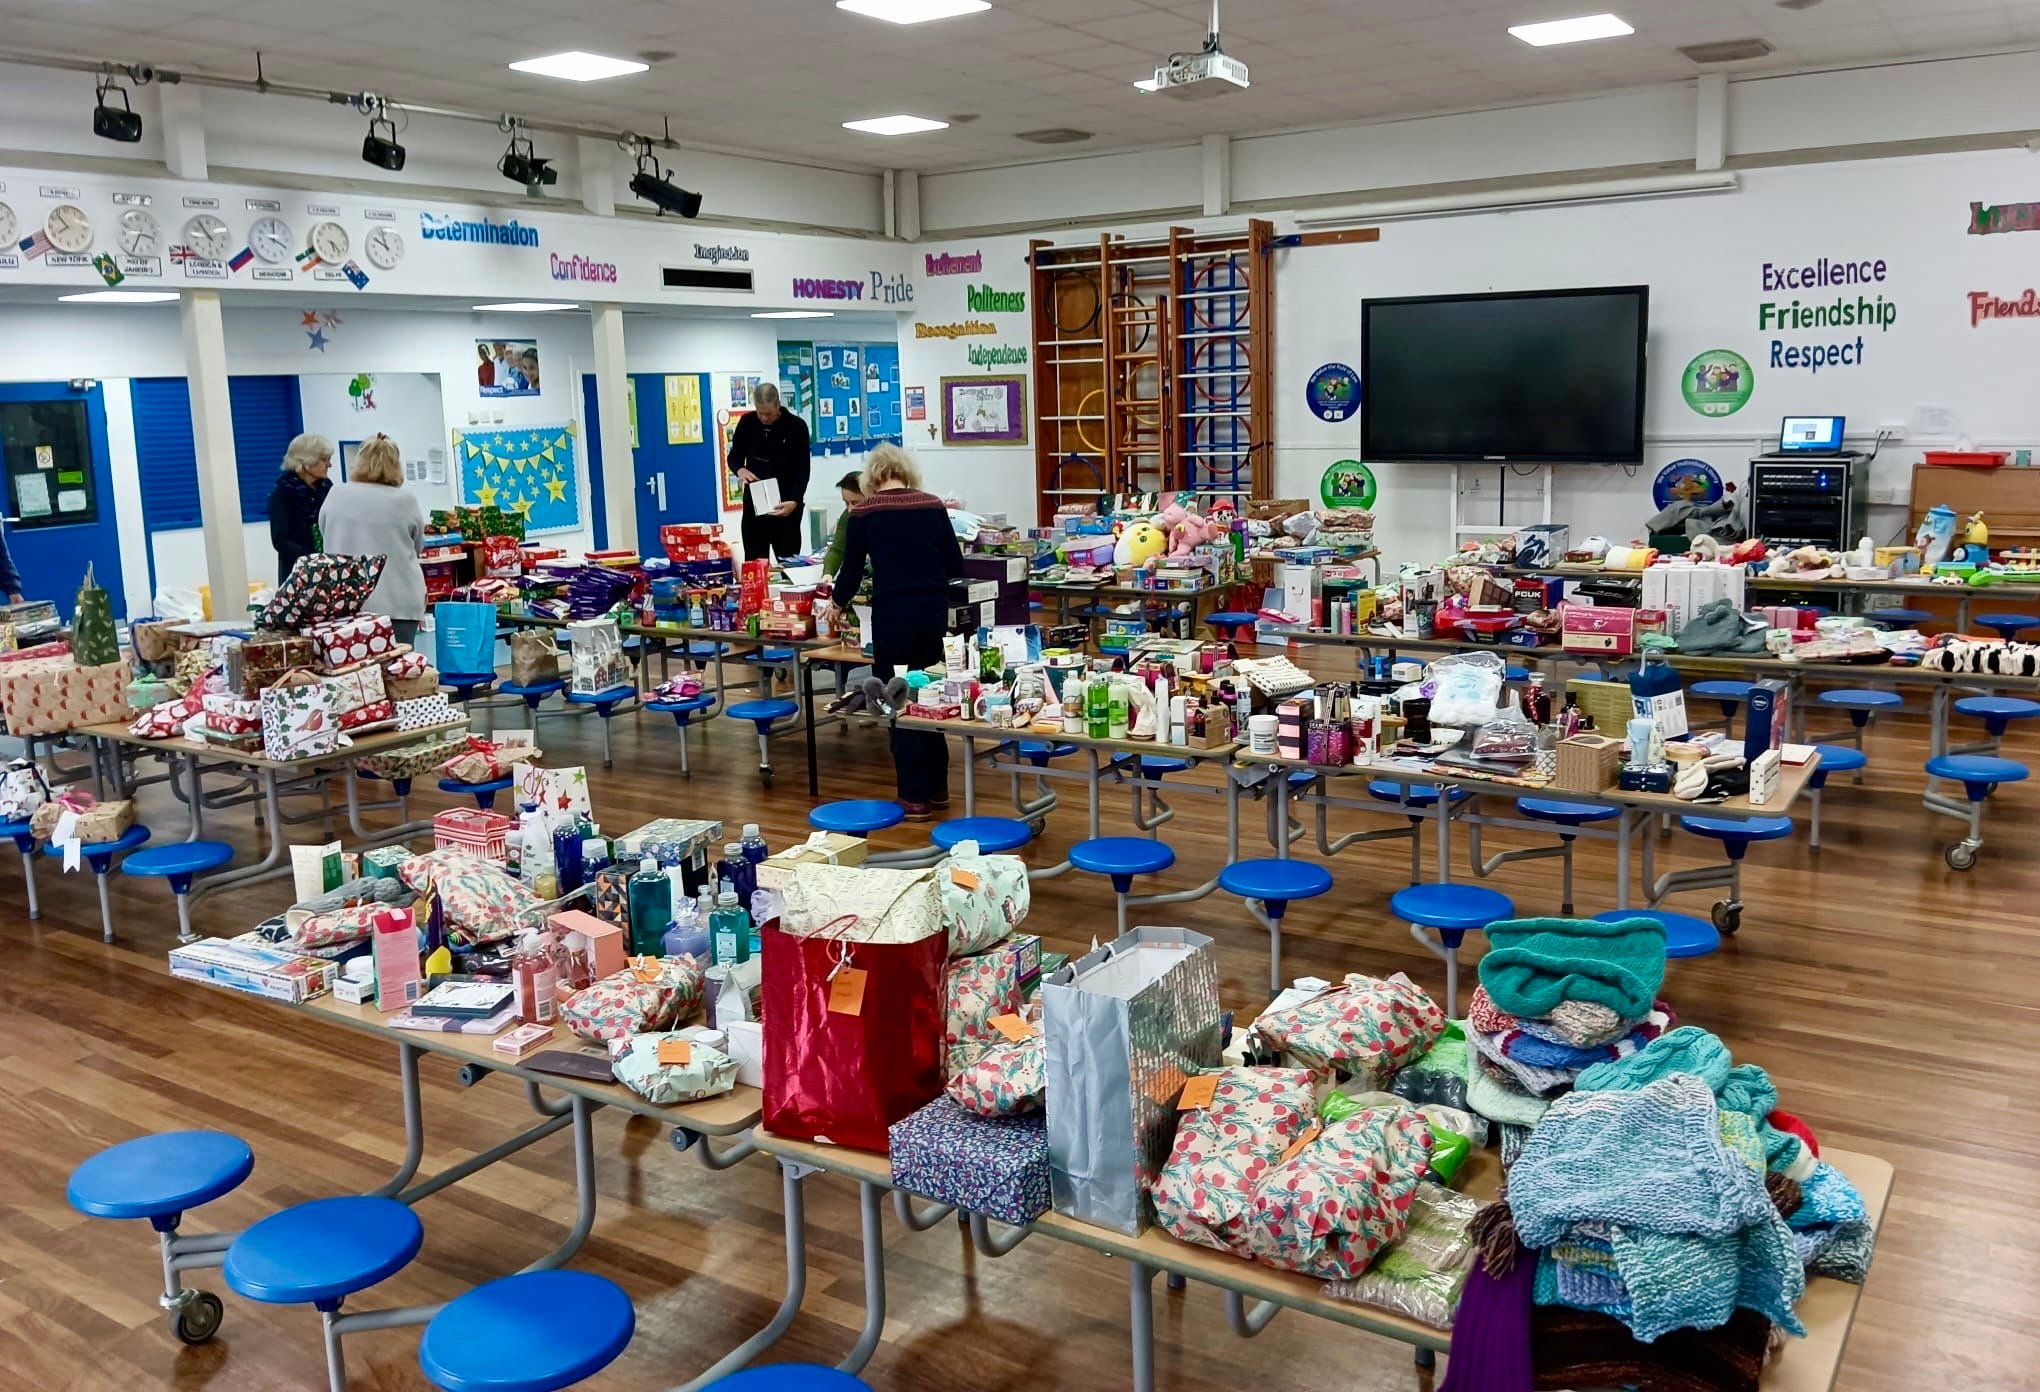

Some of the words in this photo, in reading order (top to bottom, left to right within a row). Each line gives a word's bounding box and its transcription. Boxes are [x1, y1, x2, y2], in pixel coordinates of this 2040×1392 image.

[550, 252, 618, 283] Confidence
[693, 243, 750, 265] Imagination
[792, 278, 864, 300] HONESTY
[869, 270, 914, 304] Pride
[1762, 257, 1887, 292] Excellence
[967, 283, 1026, 313] Politeness
[1759, 294, 1897, 332] Friendship
[915, 320, 997, 340] Recognition
[967, 343, 1028, 372] Independence
[1770, 335, 1864, 374] Respect
